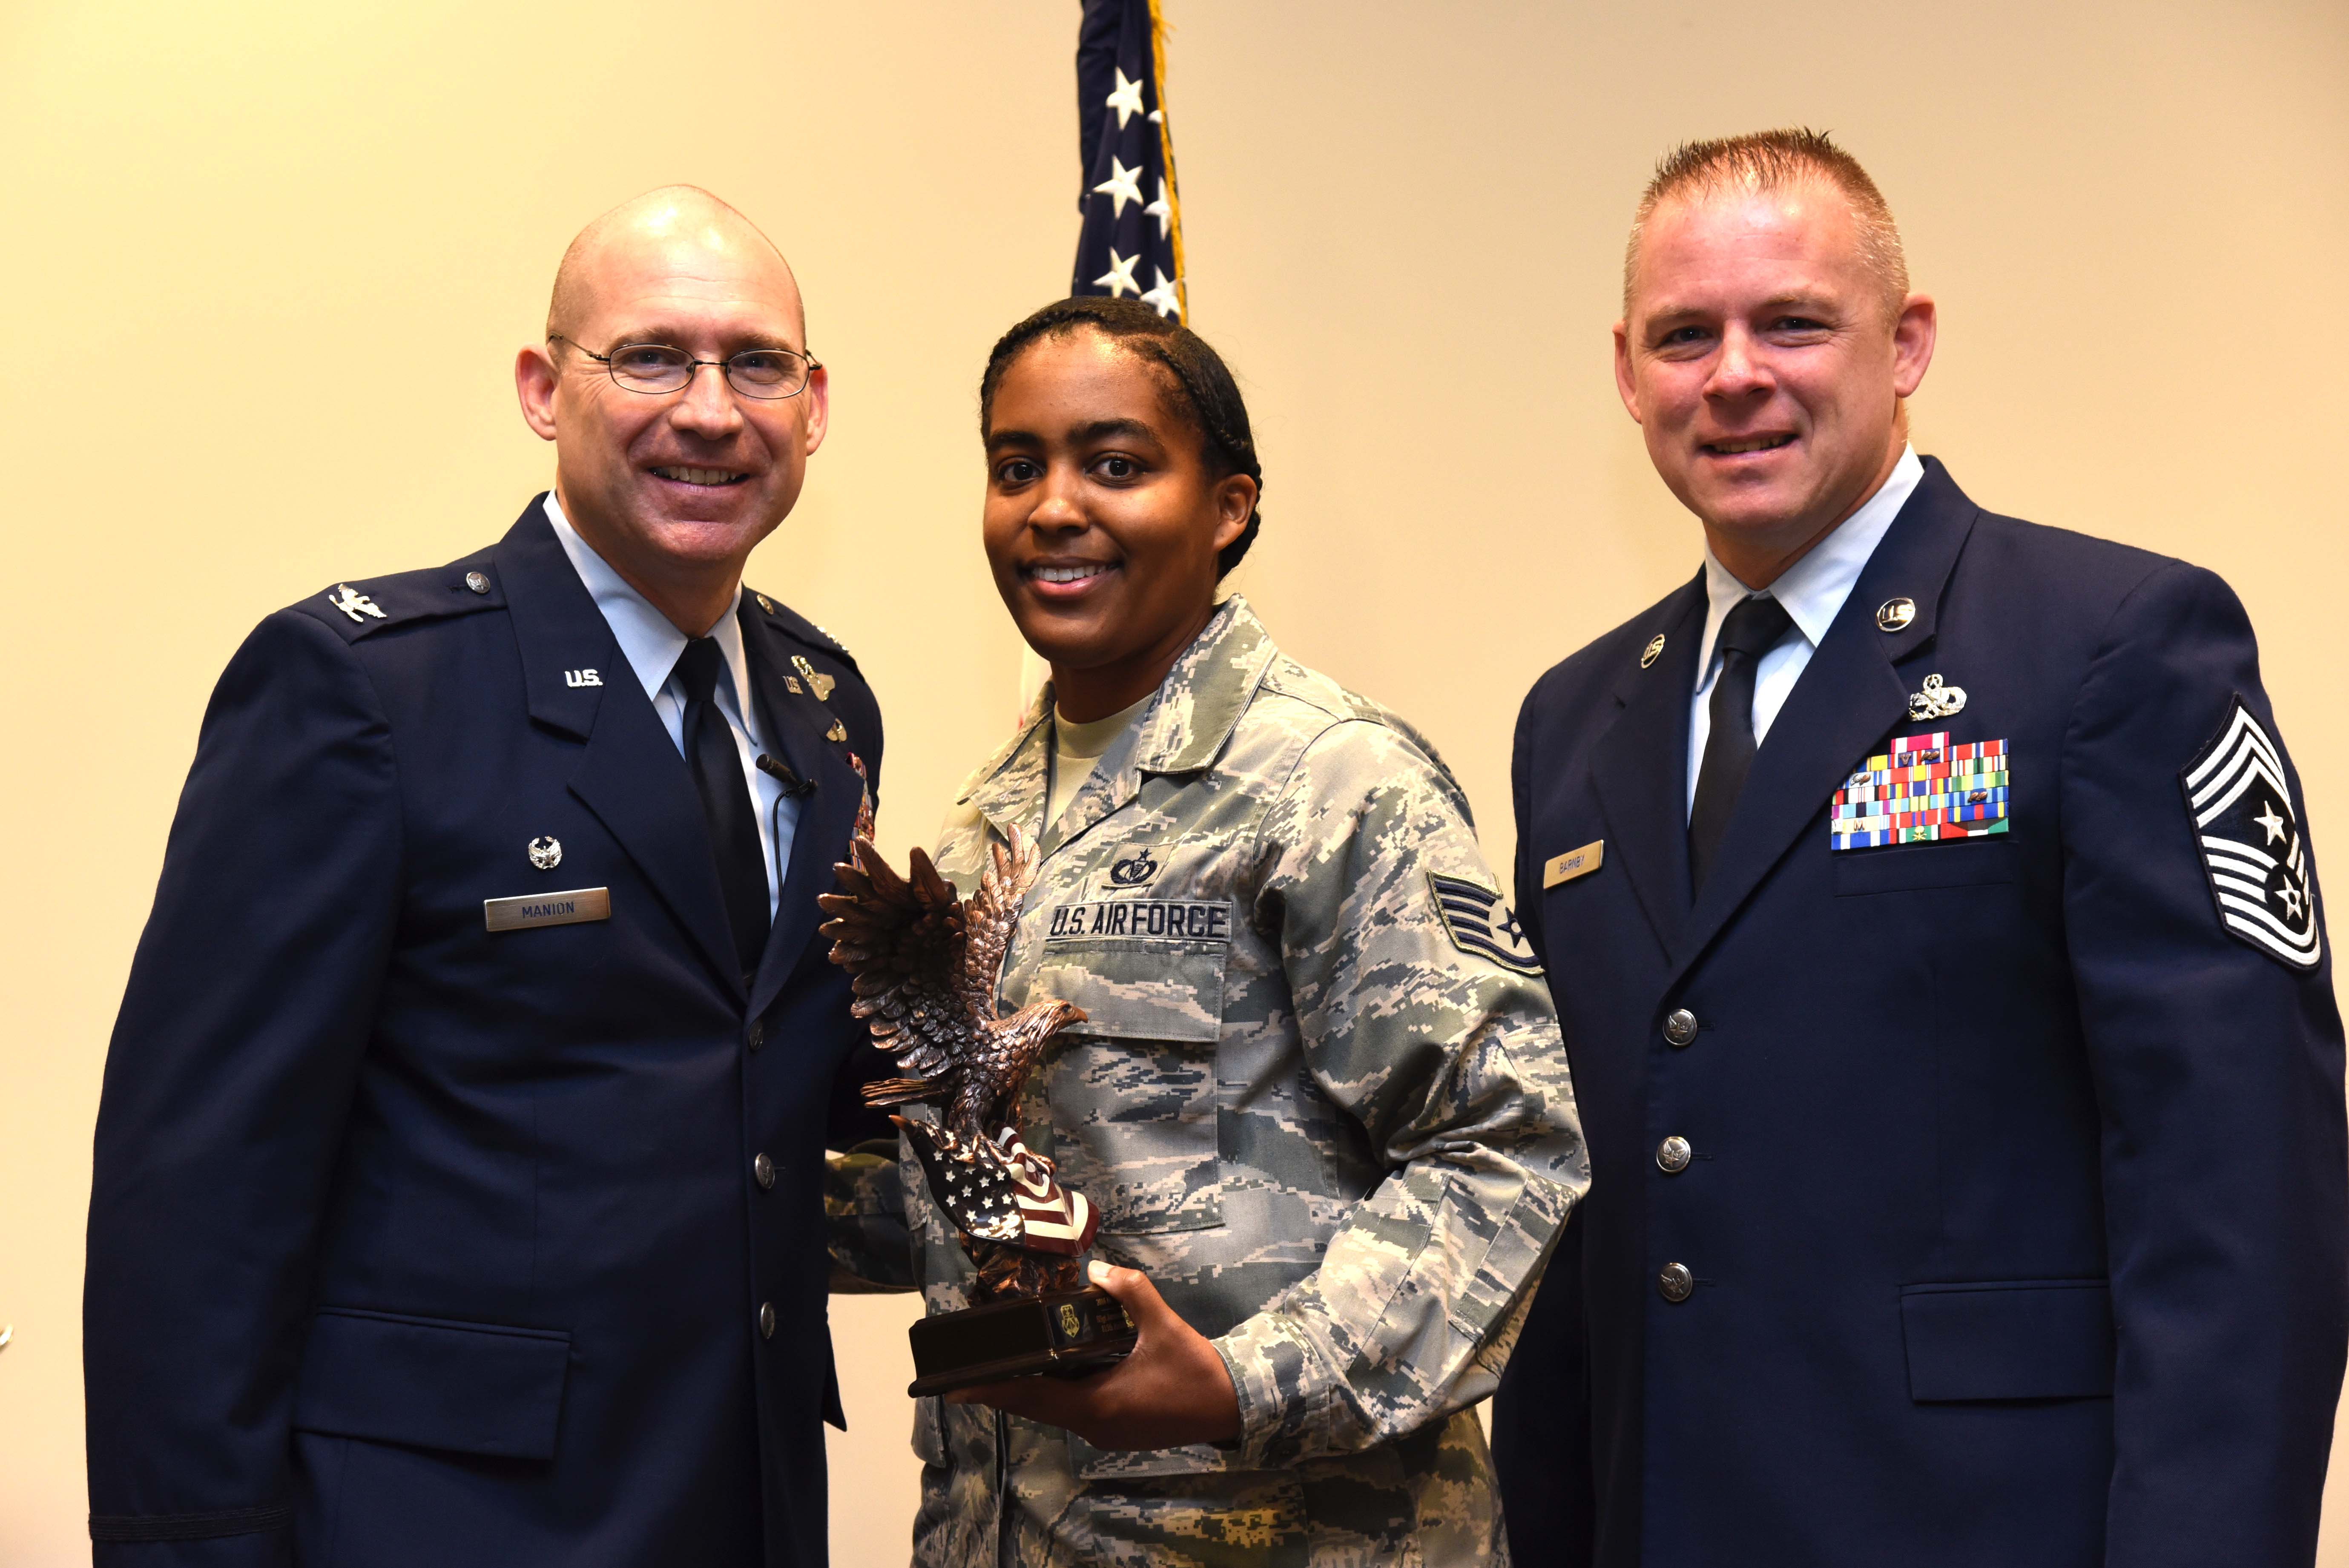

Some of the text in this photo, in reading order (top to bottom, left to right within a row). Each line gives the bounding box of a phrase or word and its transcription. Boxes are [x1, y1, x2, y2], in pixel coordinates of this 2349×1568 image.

[565, 669, 603, 687] U.S.
[1559, 853, 1585, 874] BARNBY
[522, 901, 574, 919] MANION
[1050, 904, 1227, 938] U.S. AIR FORCE
